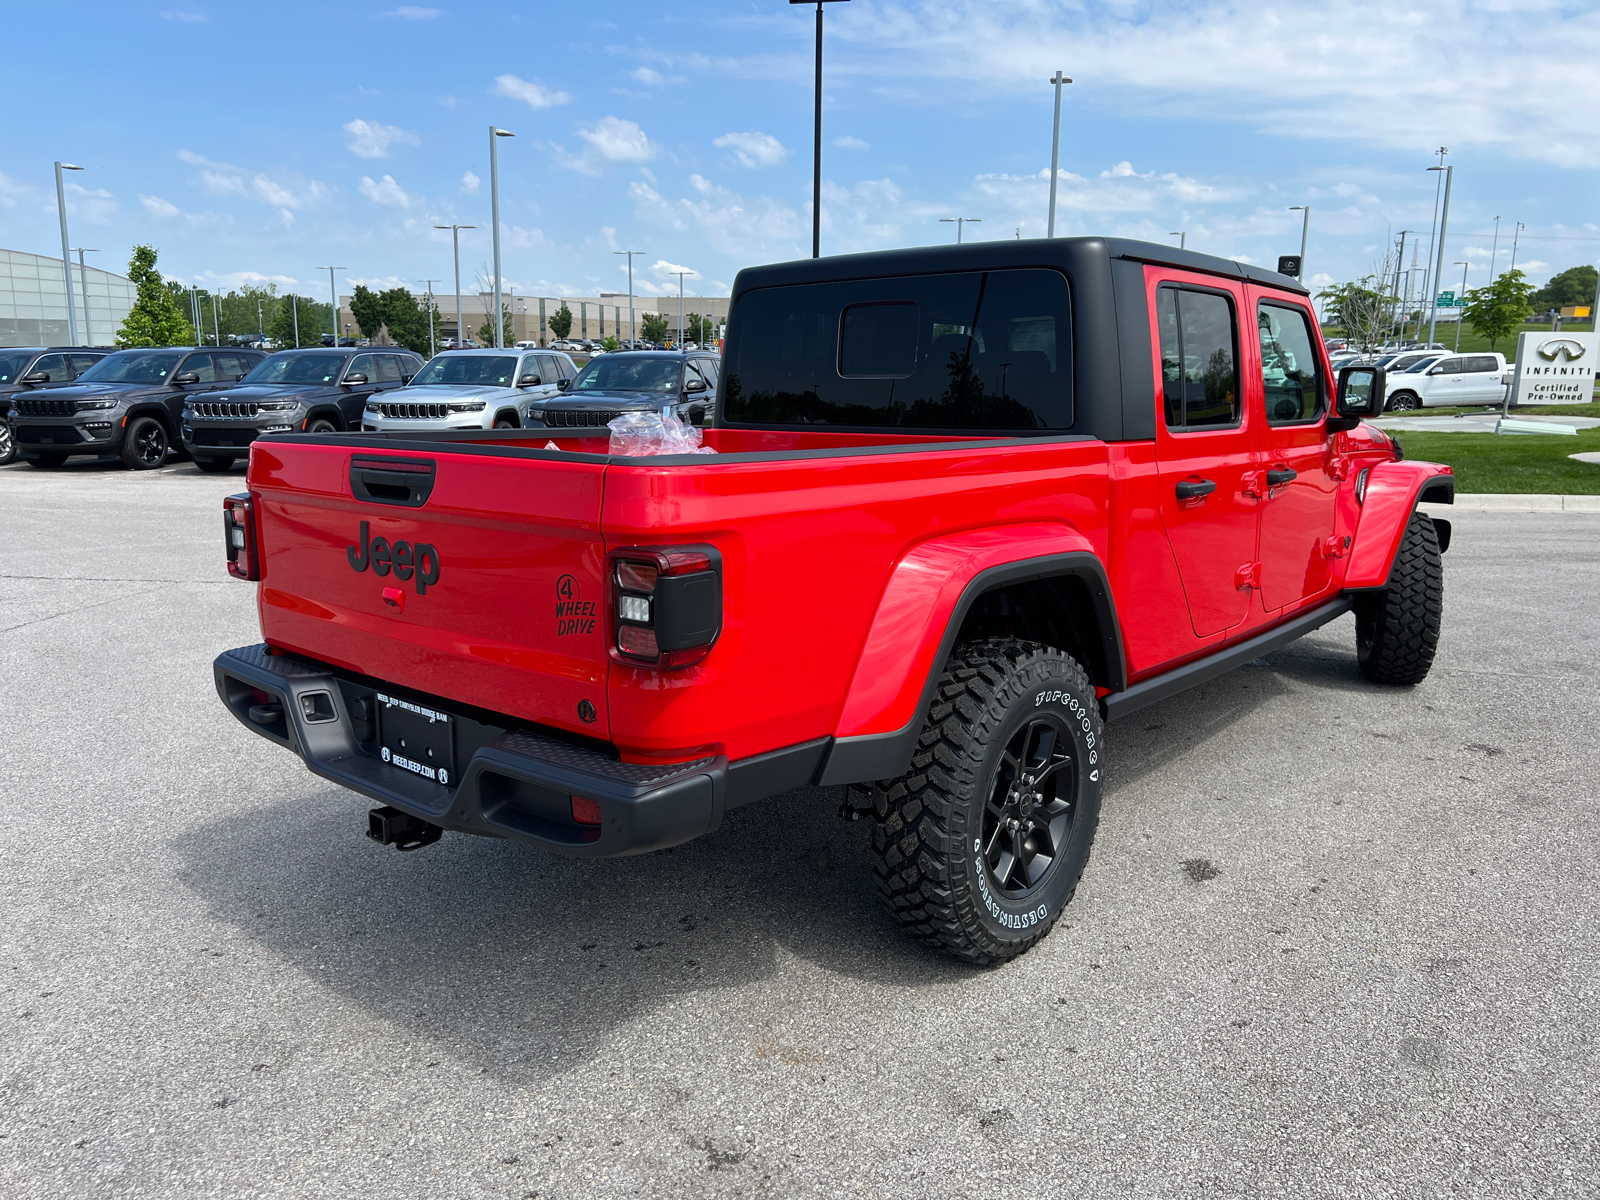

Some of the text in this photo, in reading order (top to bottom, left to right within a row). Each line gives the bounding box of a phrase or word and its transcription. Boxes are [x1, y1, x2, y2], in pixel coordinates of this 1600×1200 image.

[1526, 367, 1591, 375] INFINITI
[1528, 393, 1583, 401] Pre-Owned
[1534, 383, 1579, 392] Certified
[347, 520, 440, 595] Jeep
[560, 578, 573, 600] 4
[555, 601, 596, 618] WHEEL
[558, 618, 596, 637] DRIVE
[377, 692, 389, 703] REED
[399, 700, 421, 714] CHRYSLER
[421, 707, 436, 719] DODGE
[436, 712, 448, 722] RAM
[1035, 690, 1098, 765] Firestone
[392, 754, 436, 780] REEDJEEP.COM
[974, 856, 1048, 929] DESTINATION
